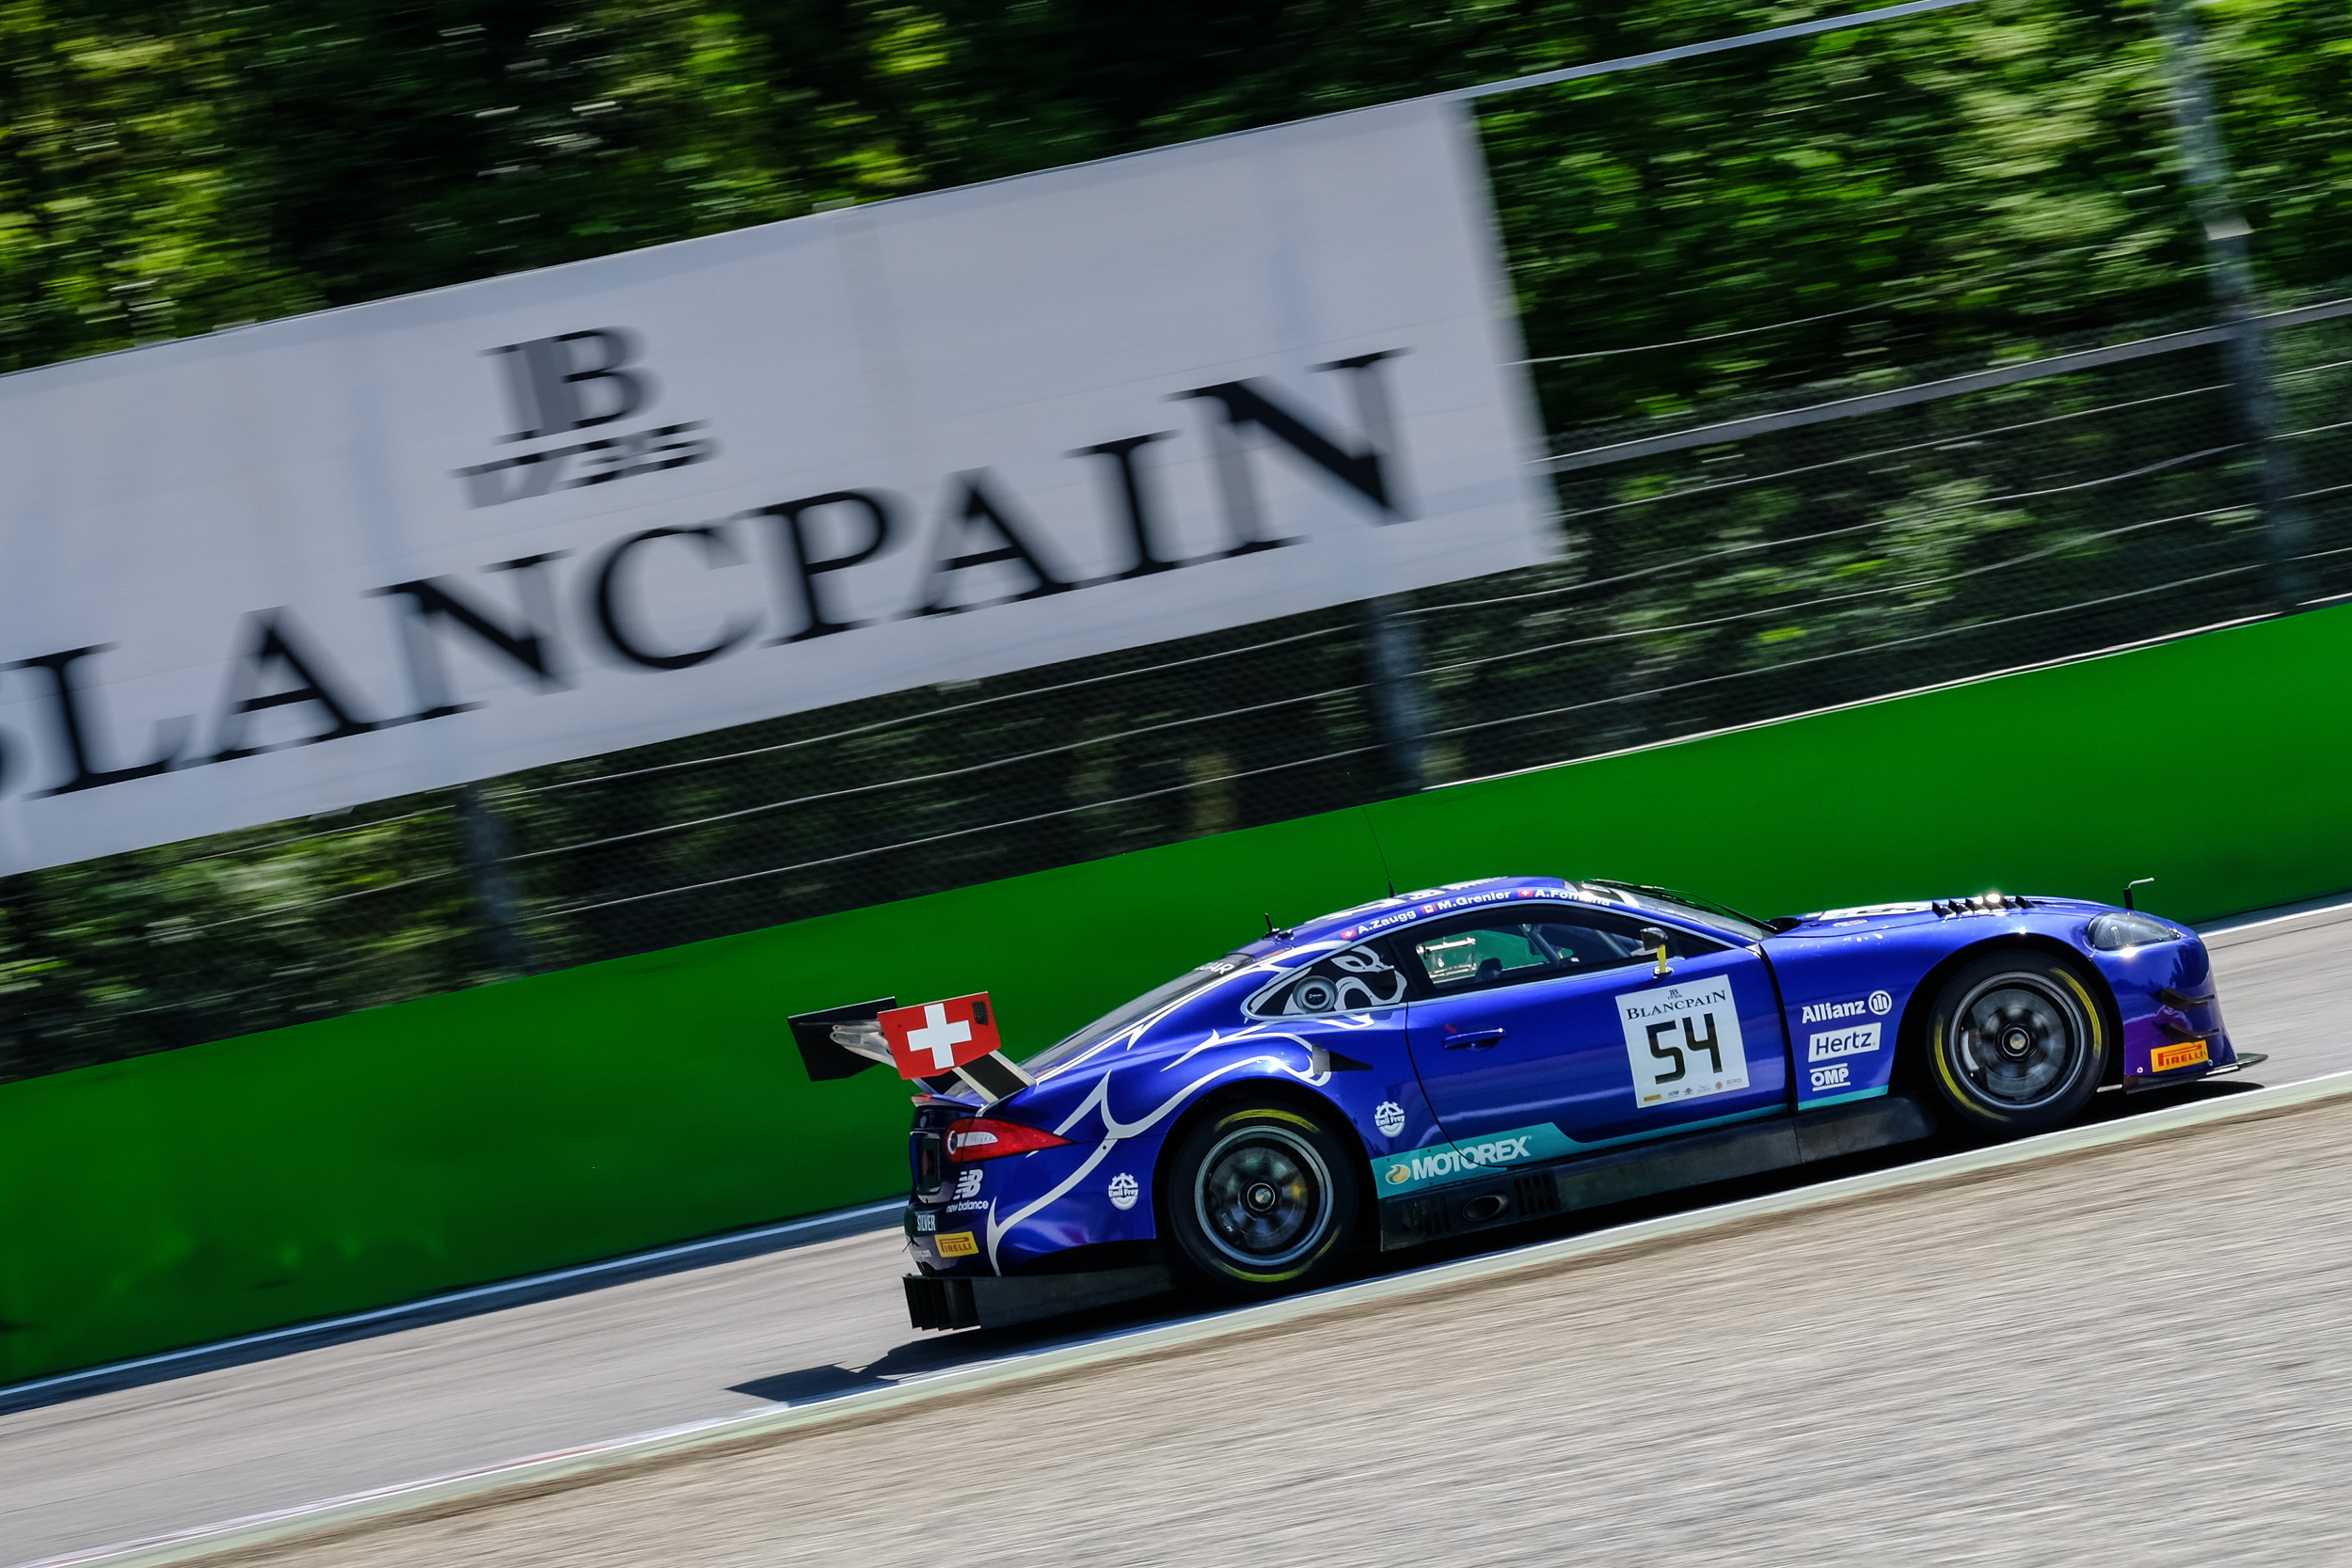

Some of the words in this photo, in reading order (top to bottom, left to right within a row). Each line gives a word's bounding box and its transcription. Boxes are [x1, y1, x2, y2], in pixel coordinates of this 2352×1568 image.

[0, 347, 1414, 801] LANCPAIN
[1534, 889, 1611, 906] A.Fonna
[1358, 910, 1417, 935] A.Zaugg
[1626, 990, 1726, 1021] BLANCPAIN
[1802, 1000, 1867, 1024] Allianz
[1645, 1012, 1723, 1085] 54
[1816, 1032, 1872, 1055] Hertz
[2157, 1044, 2203, 1067] PIRELLI
[1811, 1068, 1849, 1086] OMP
[1412, 1135, 1532, 1180] MOTOREX
[946, 1205, 958, 1213] new
[958, 1200, 989, 1212] balance
[939, 1237, 972, 1253] PIRELLI
